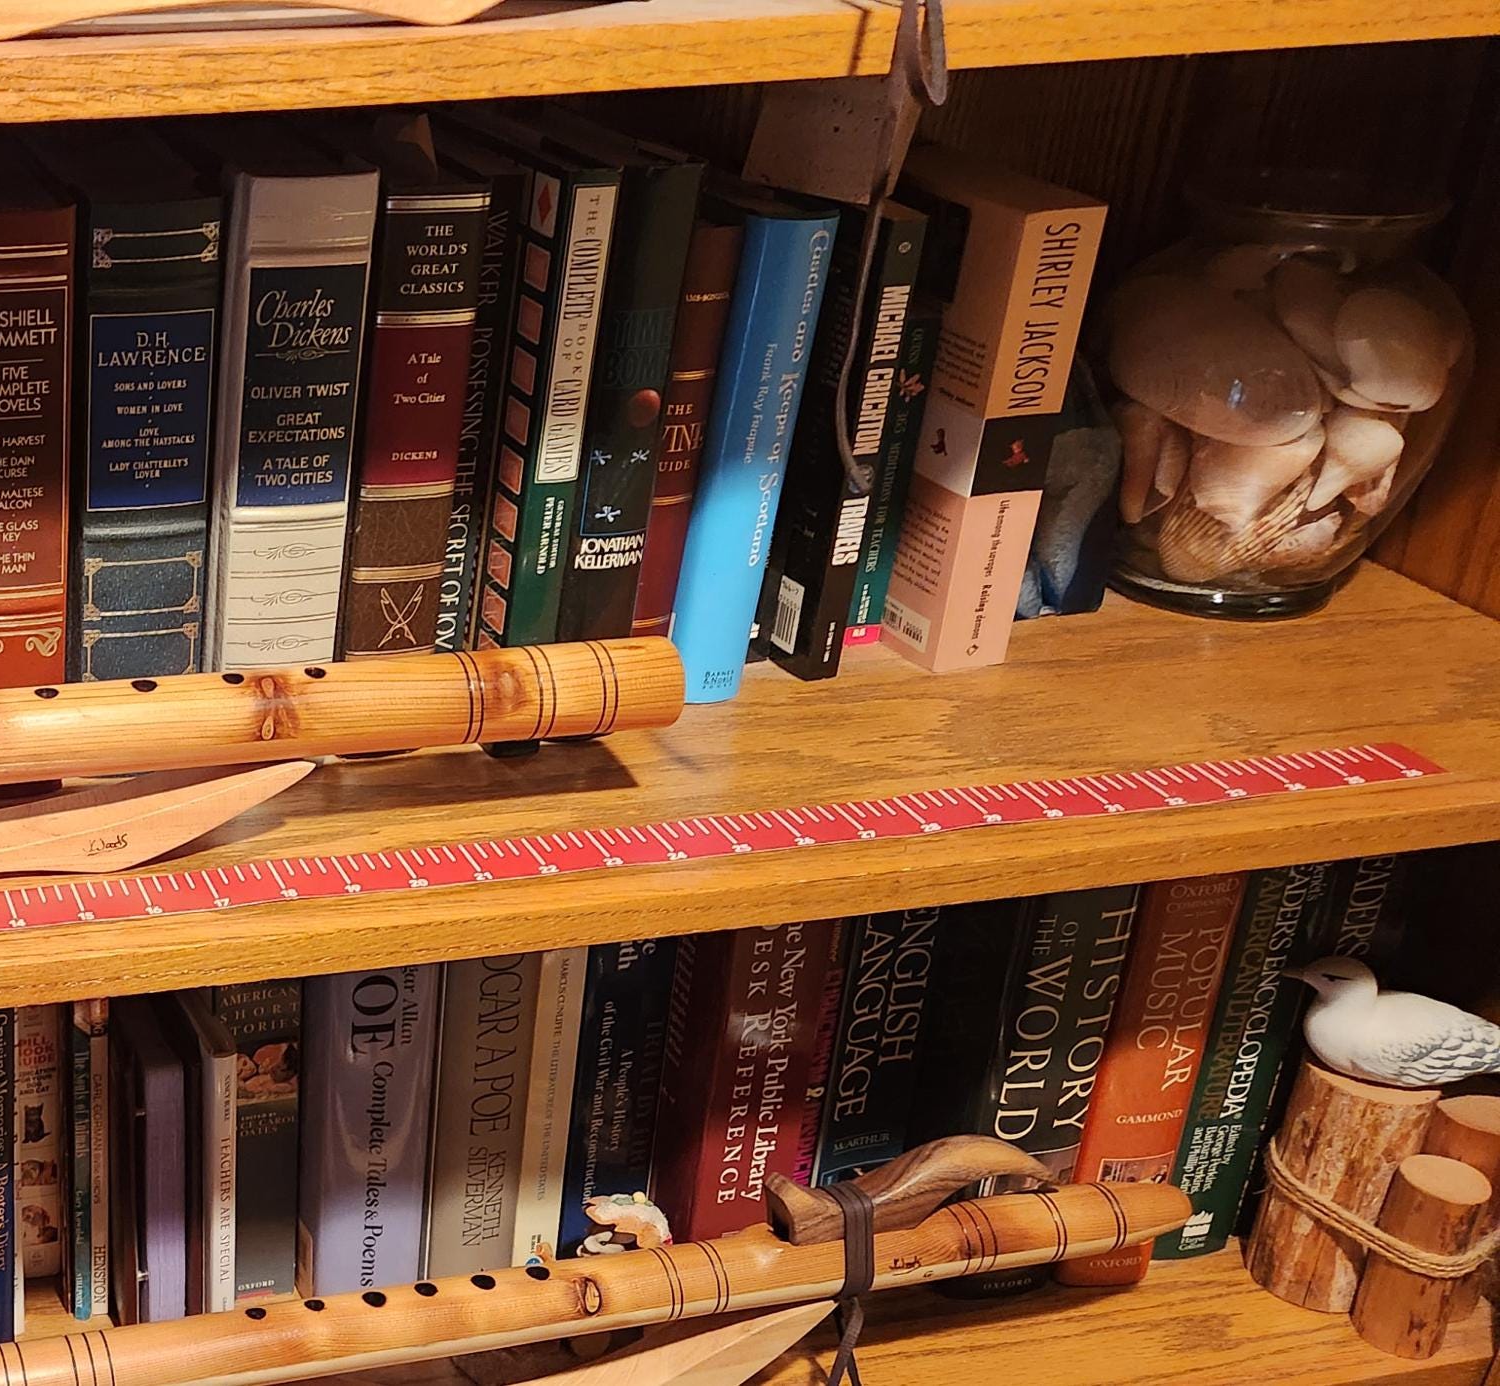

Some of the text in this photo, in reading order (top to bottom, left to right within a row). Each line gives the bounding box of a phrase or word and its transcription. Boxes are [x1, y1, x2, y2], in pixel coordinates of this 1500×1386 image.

[425, 225, 453, 237] THE
[407, 243, 468, 256] WORLD'S
[564, 194, 603, 320] THE COMPLETE
[411, 263, 459, 275] GREAT
[400, 281, 464, 295] CLASSICS
[256, 289, 335, 327] Charles
[1007, 222, 1080, 410] SHIRLEY JACKSON
[137, 332, 170, 348] D. H.
[268, 319, 352, 348] Dickens
[98, 347, 206, 367] LAWRENCE
[420, 353, 441, 364] Tale
[572, 322, 588, 375] BOOK
[1, 366, 29, 381] FIVE
[417, 373, 428, 385] of
[852, 284, 911, 456] MICHAEL CRICHTON
[251, 382, 350, 399] OLIVER TWIST
[393, 393, 445, 405] Two Cities
[748, 229, 830, 567] Castles and Keeps Scotland
[277, 412, 322, 426] GREAT
[544, 379, 583, 474] CARD GAMES
[2, 434, 46, 447] HARVEST
[248, 427, 346, 443] EXPECTATIONS
[263, 454, 330, 470] A TALE OF
[391, 450, 438, 461] DICKENS
[255, 470, 333, 486] TWO CITIES
[1, 488, 44, 499] MALTESE
[831, 495, 871, 567] TRAVELS
[580, 533, 645, 554] JONATHAN
[574, 550, 643, 570] KELLERMAN
[9, 918, 26, 927] 14
[78, 911, 94, 921] 15
[145, 905, 162, 914] 16
[1060, 920, 1079, 947] OF
[1232, 877, 1285, 994] AMERICAN
[220, 987, 299, 1007] AMERICAN
[1135, 927, 1193, 1050] MUSIC
[219, 1003, 299, 1024] SHORT
[1053, 903, 1138, 1132] HISTORY
[1161, 924, 1226, 1091] POPULAR
[401, 1000, 419, 1044] Allan
[994, 914, 1073, 1140] THE WORLD
[1219, 954, 1288, 1119] ENCYCLOPEDIA
[741, 948, 805, 1202] New York Public Library
[469, 1046, 518, 1137] A POE
[716, 1010, 771, 1205] REFERENCE
[1115, 1108, 1183, 1125] GAMMOND
[360, 1060, 395, 1288] Complete Tales Poems
[462, 1146, 489, 1246] SILVERMAN
[481, 1149, 507, 1240] KENNETH
[219, 1138, 231, 1284] TEACHERS ARE SPECIAL
[93, 1245, 106, 1304] HENSTON
[237, 1279, 275, 1291] OXFORD
